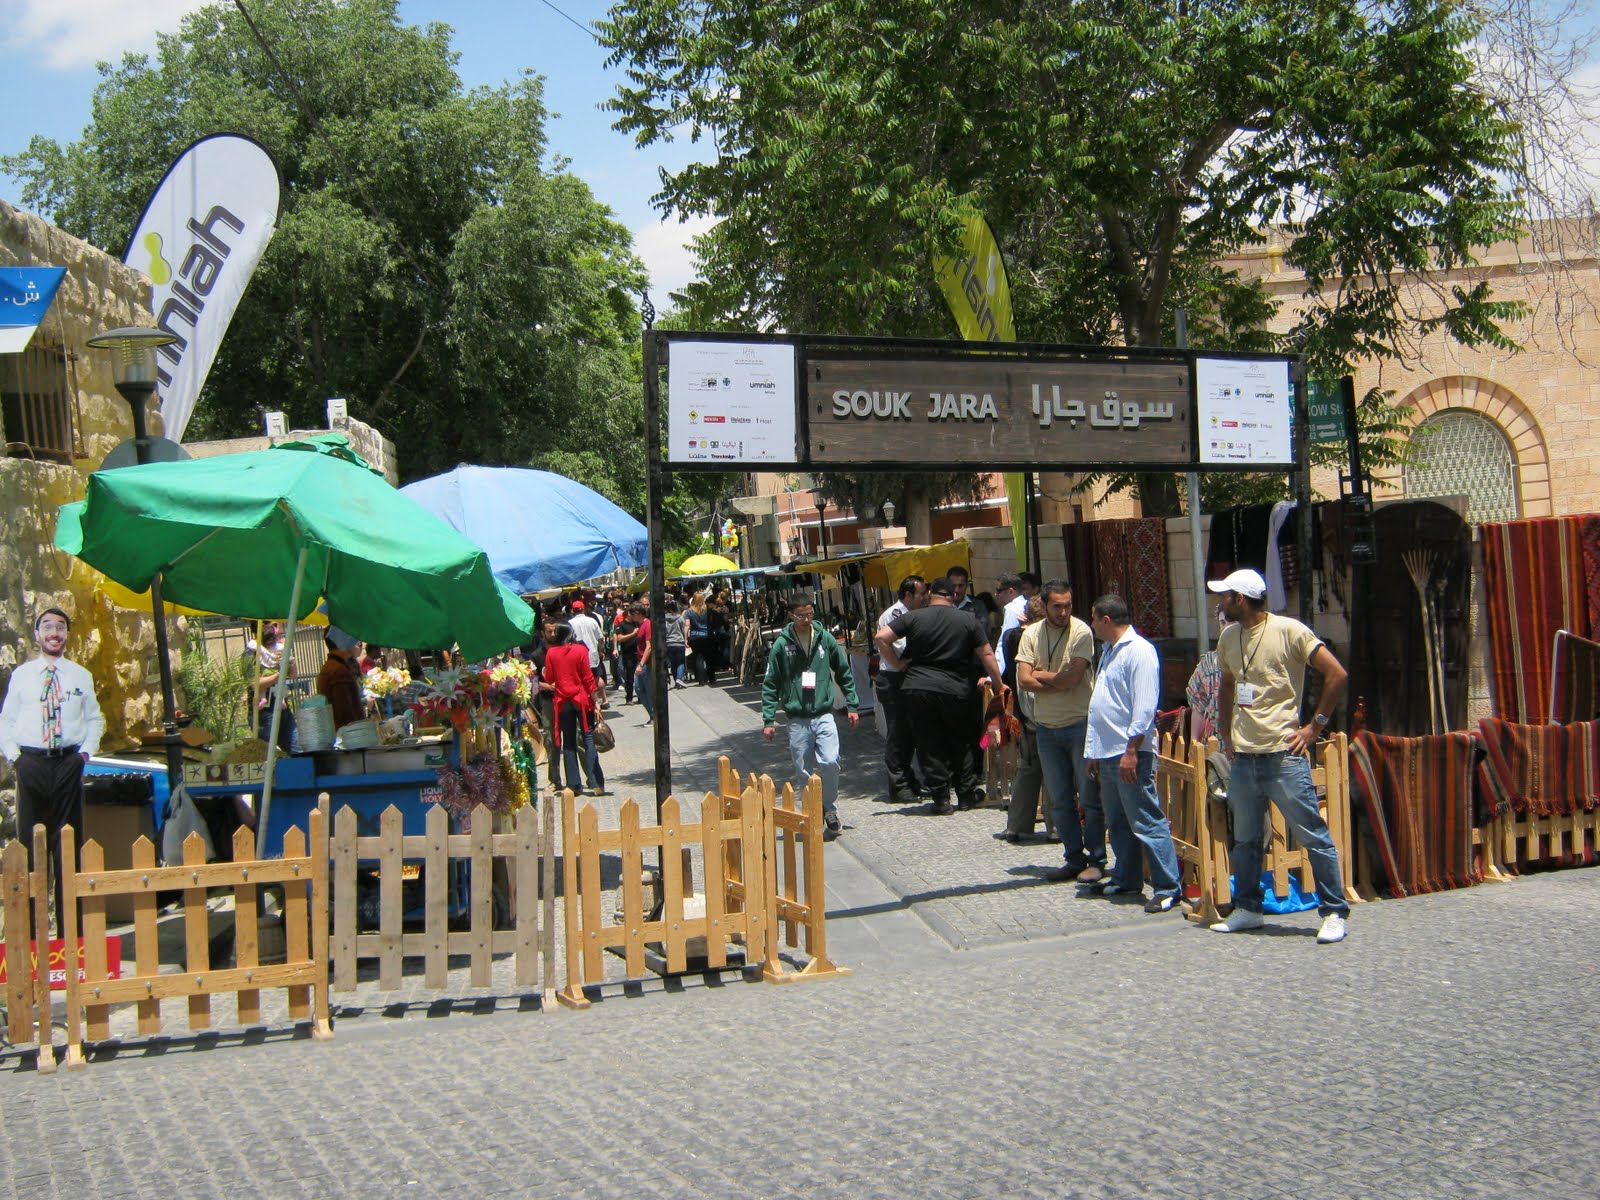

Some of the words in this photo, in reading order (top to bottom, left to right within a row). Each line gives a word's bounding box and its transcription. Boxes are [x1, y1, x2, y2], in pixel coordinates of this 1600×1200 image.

[156, 204, 246, 408] niah
[832, 390, 912, 419] SOUK
[928, 392, 999, 420] JARA
[1031, 383, 1086, 427] جارا
[1090, 391, 1174, 428] سوق
[1330, 403, 1343, 415] St.
[420, 787, 443, 795] LIQUI
